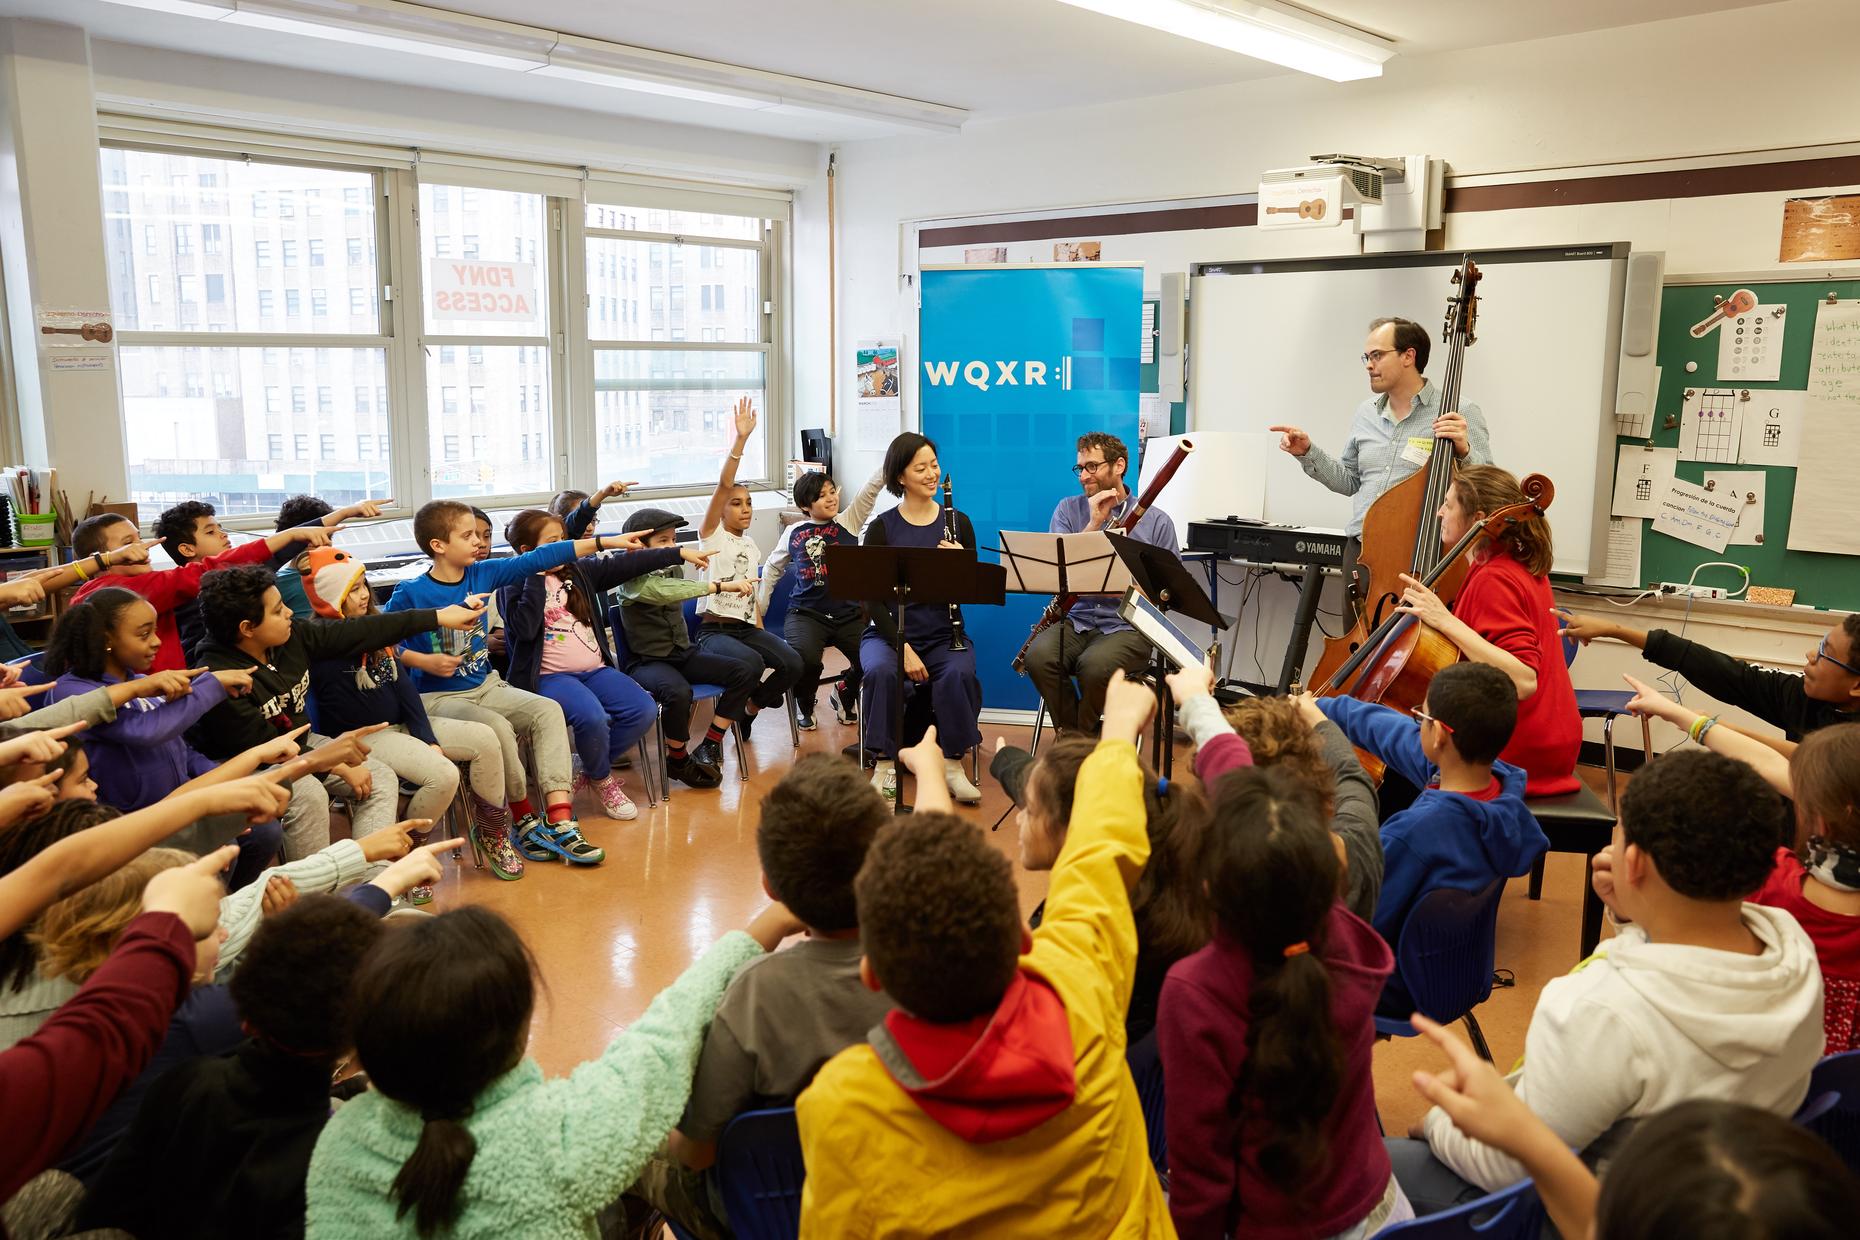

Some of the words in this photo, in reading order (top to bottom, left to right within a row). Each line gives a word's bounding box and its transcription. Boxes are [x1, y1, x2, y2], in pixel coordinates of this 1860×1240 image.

[924, 360, 1047, 391] WQXR
[1769, 408, 1779, 419] G
[1643, 464, 1650, 473] F
[1730, 490, 1737, 499] A
[792, 528, 811, 548] HERE
[1306, 542, 1342, 556] YAMAHA
